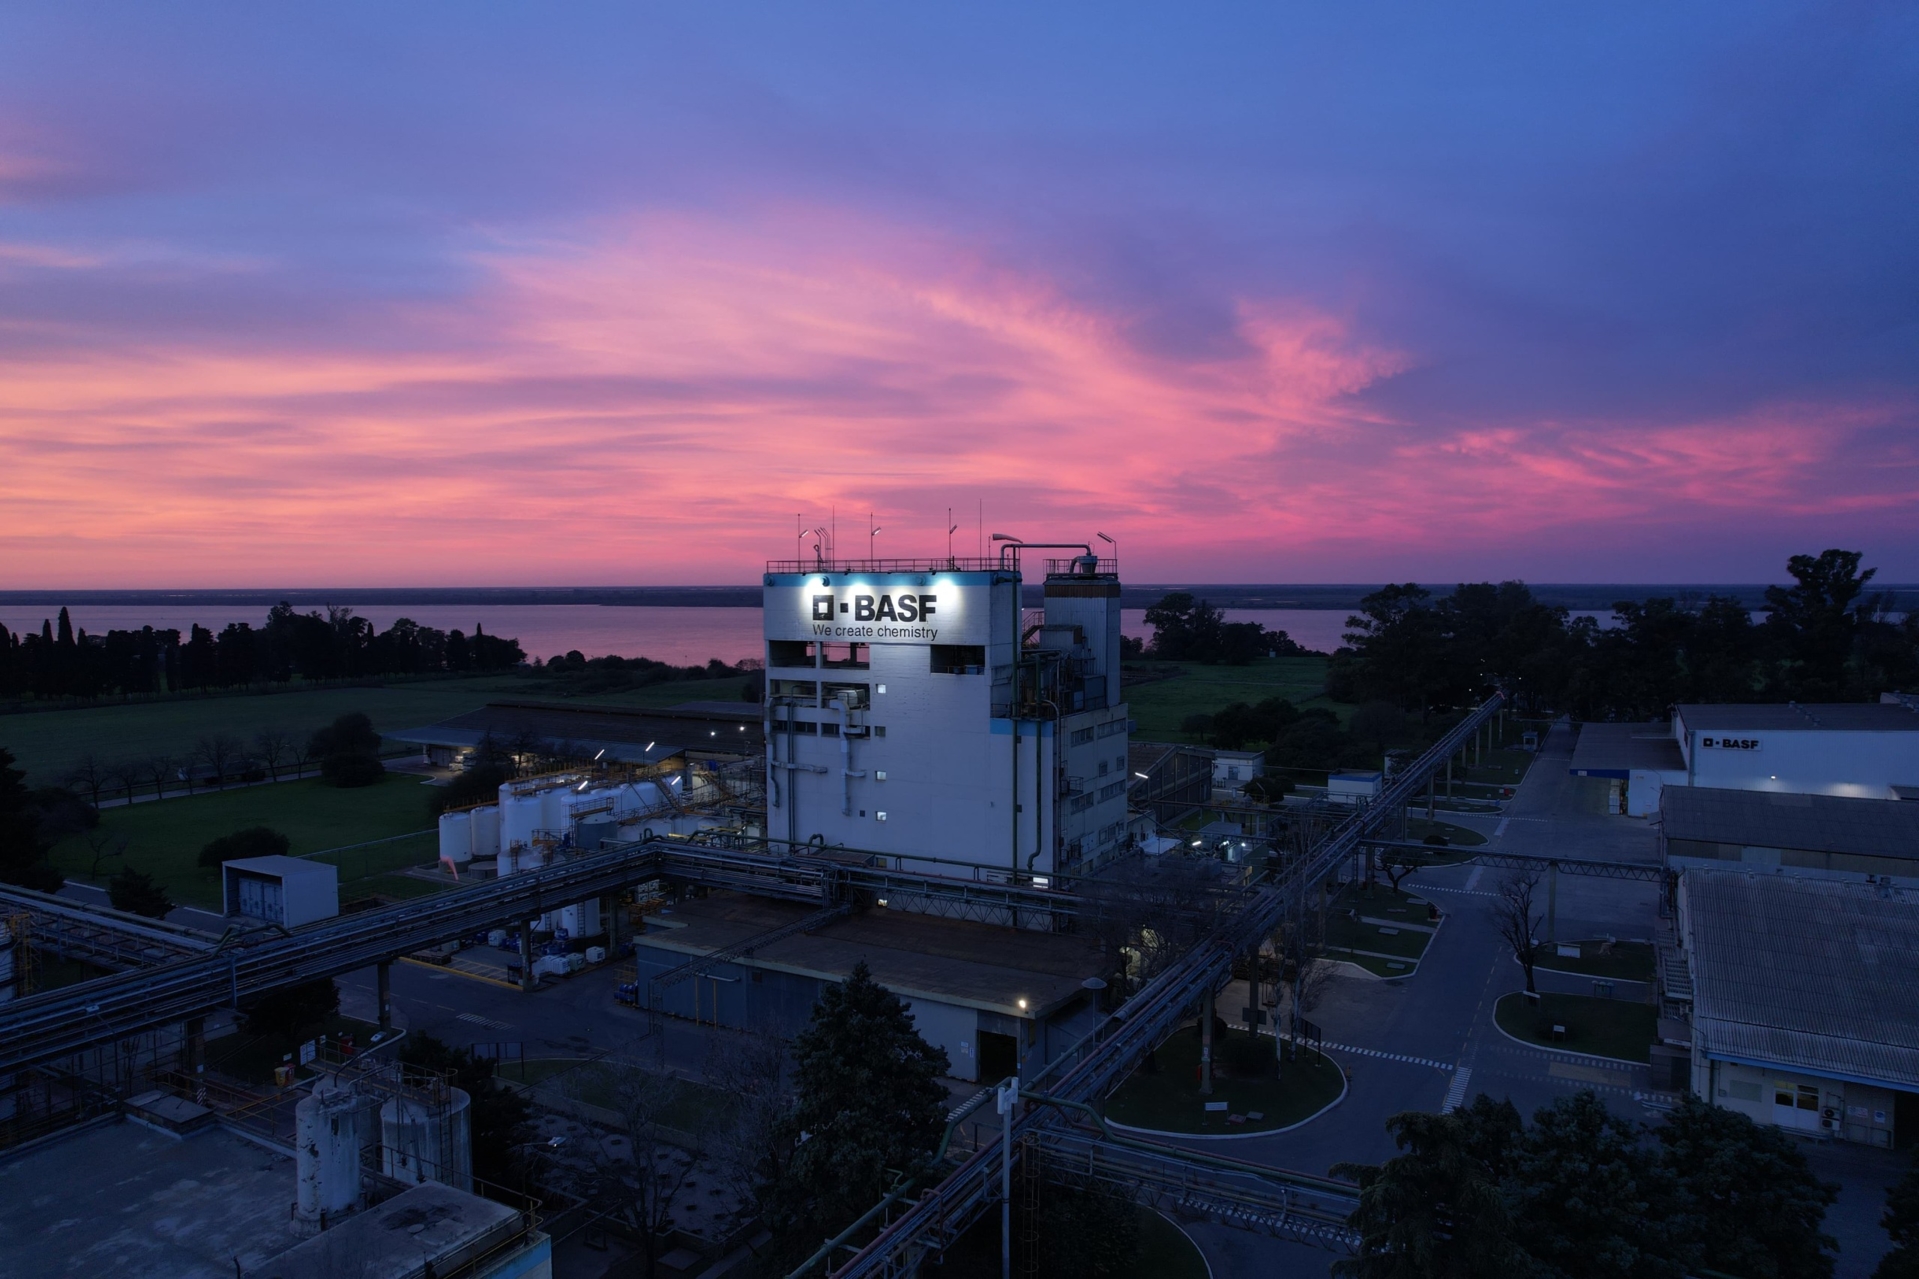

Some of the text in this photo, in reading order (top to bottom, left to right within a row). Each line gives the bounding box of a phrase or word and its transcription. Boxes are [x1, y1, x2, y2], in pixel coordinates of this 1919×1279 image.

[855, 595, 937, 622] BASF
[813, 624, 938, 641] We create chemistry
[1722, 739, 1759, 749] BASF
